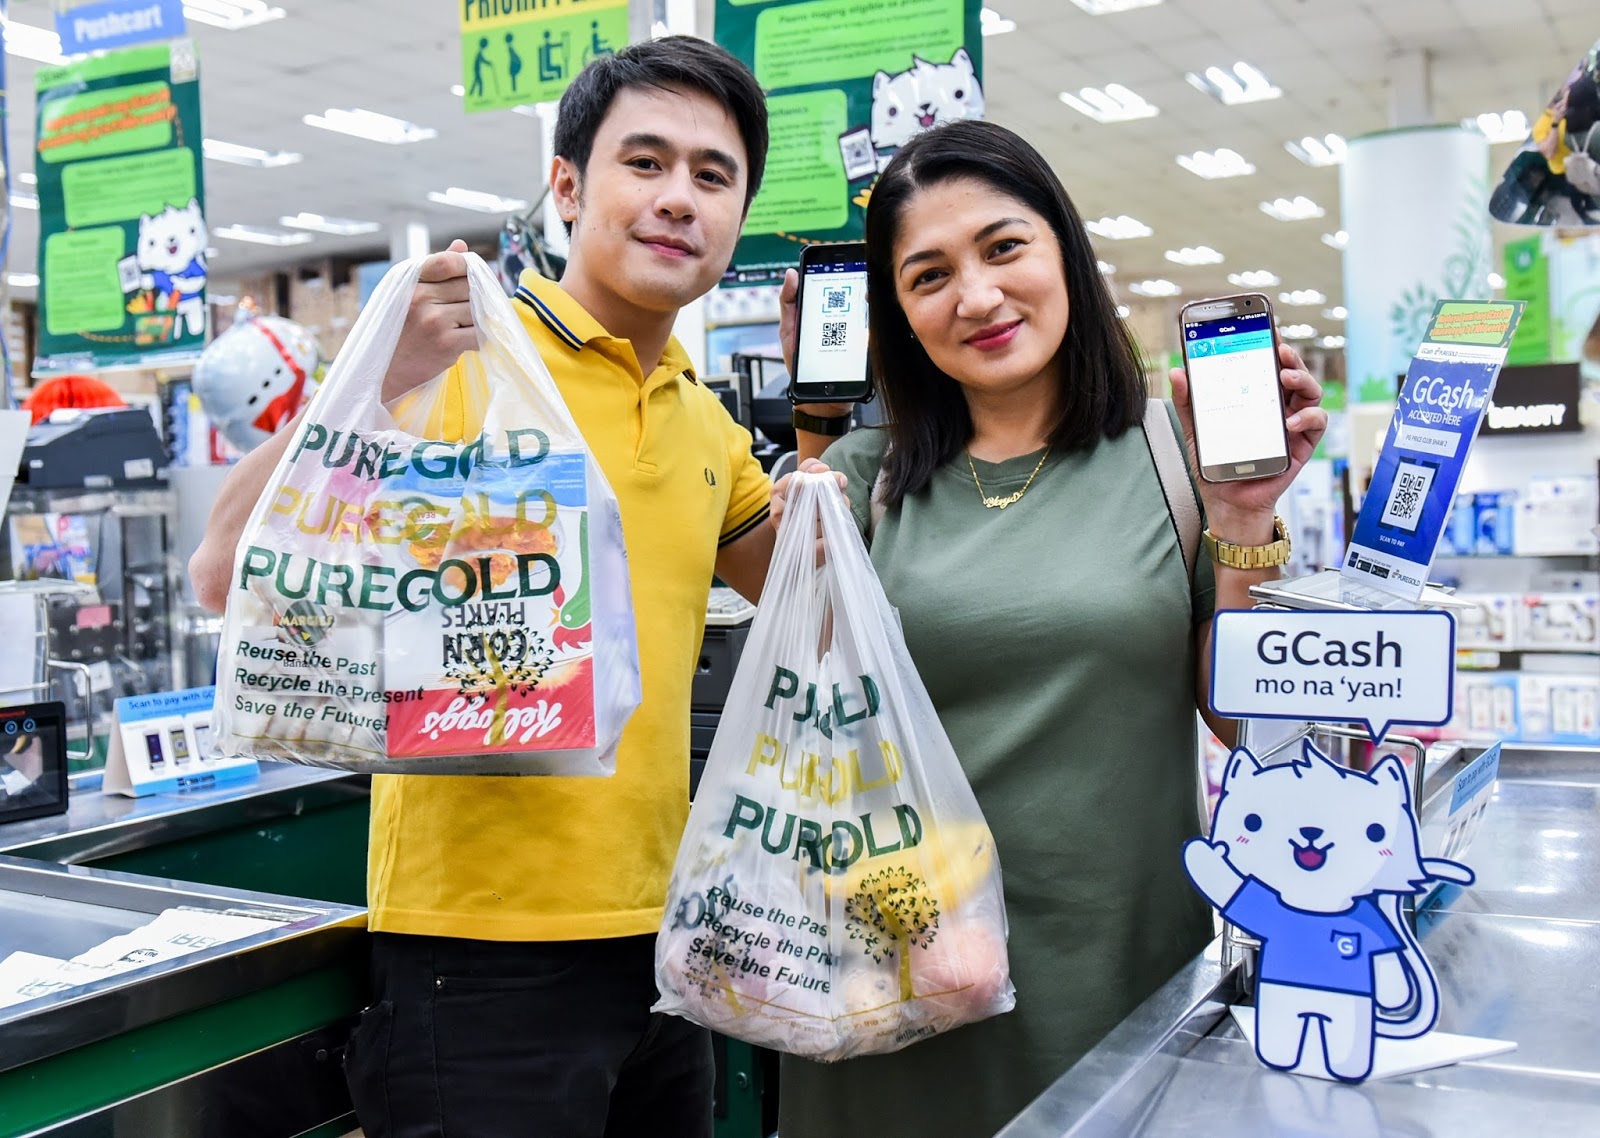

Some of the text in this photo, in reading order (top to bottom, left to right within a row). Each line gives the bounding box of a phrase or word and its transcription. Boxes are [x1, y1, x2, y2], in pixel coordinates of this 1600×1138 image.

[74, 4, 163, 43] Pushcart
[1412, 375, 1475, 410] GCash
[1408, 409, 1462, 427] ACCEPTED HERE
[1379, 534, 1390, 543] SCAN
[1391, 537, 1397, 545] TO
[238, 545, 561, 612] PUREGOLD
[1398, 574, 1421, 587] PUREGOLD
[442, 601, 525, 628] FLAKES
[236, 640, 297, 662] Reuse
[303, 651, 332, 669] the
[336, 657, 377, 675] Past
[442, 629, 528, 665] CORN
[1257, 630, 1402, 668] GCash
[128, 699, 150, 710] Scan
[152, 698, 162, 706] to
[165, 697, 179, 706] pay
[182, 692, 200, 701] with
[235, 668, 424, 703] Recycle the Present
[1256, 678, 1295, 694] mo
[1303, 680, 1334, 696] na
[235, 695, 277, 715] Save
[283, 702, 315, 719] the
[321, 705, 390, 731] Future!
[706, 886, 828, 937] Reuse the Pas
[699, 912, 770, 948] Recycle
[777, 938, 803, 957] the
[1337, 937, 1353, 955] G
[690, 938, 735, 966] Save
[740, 955, 770, 977] the
